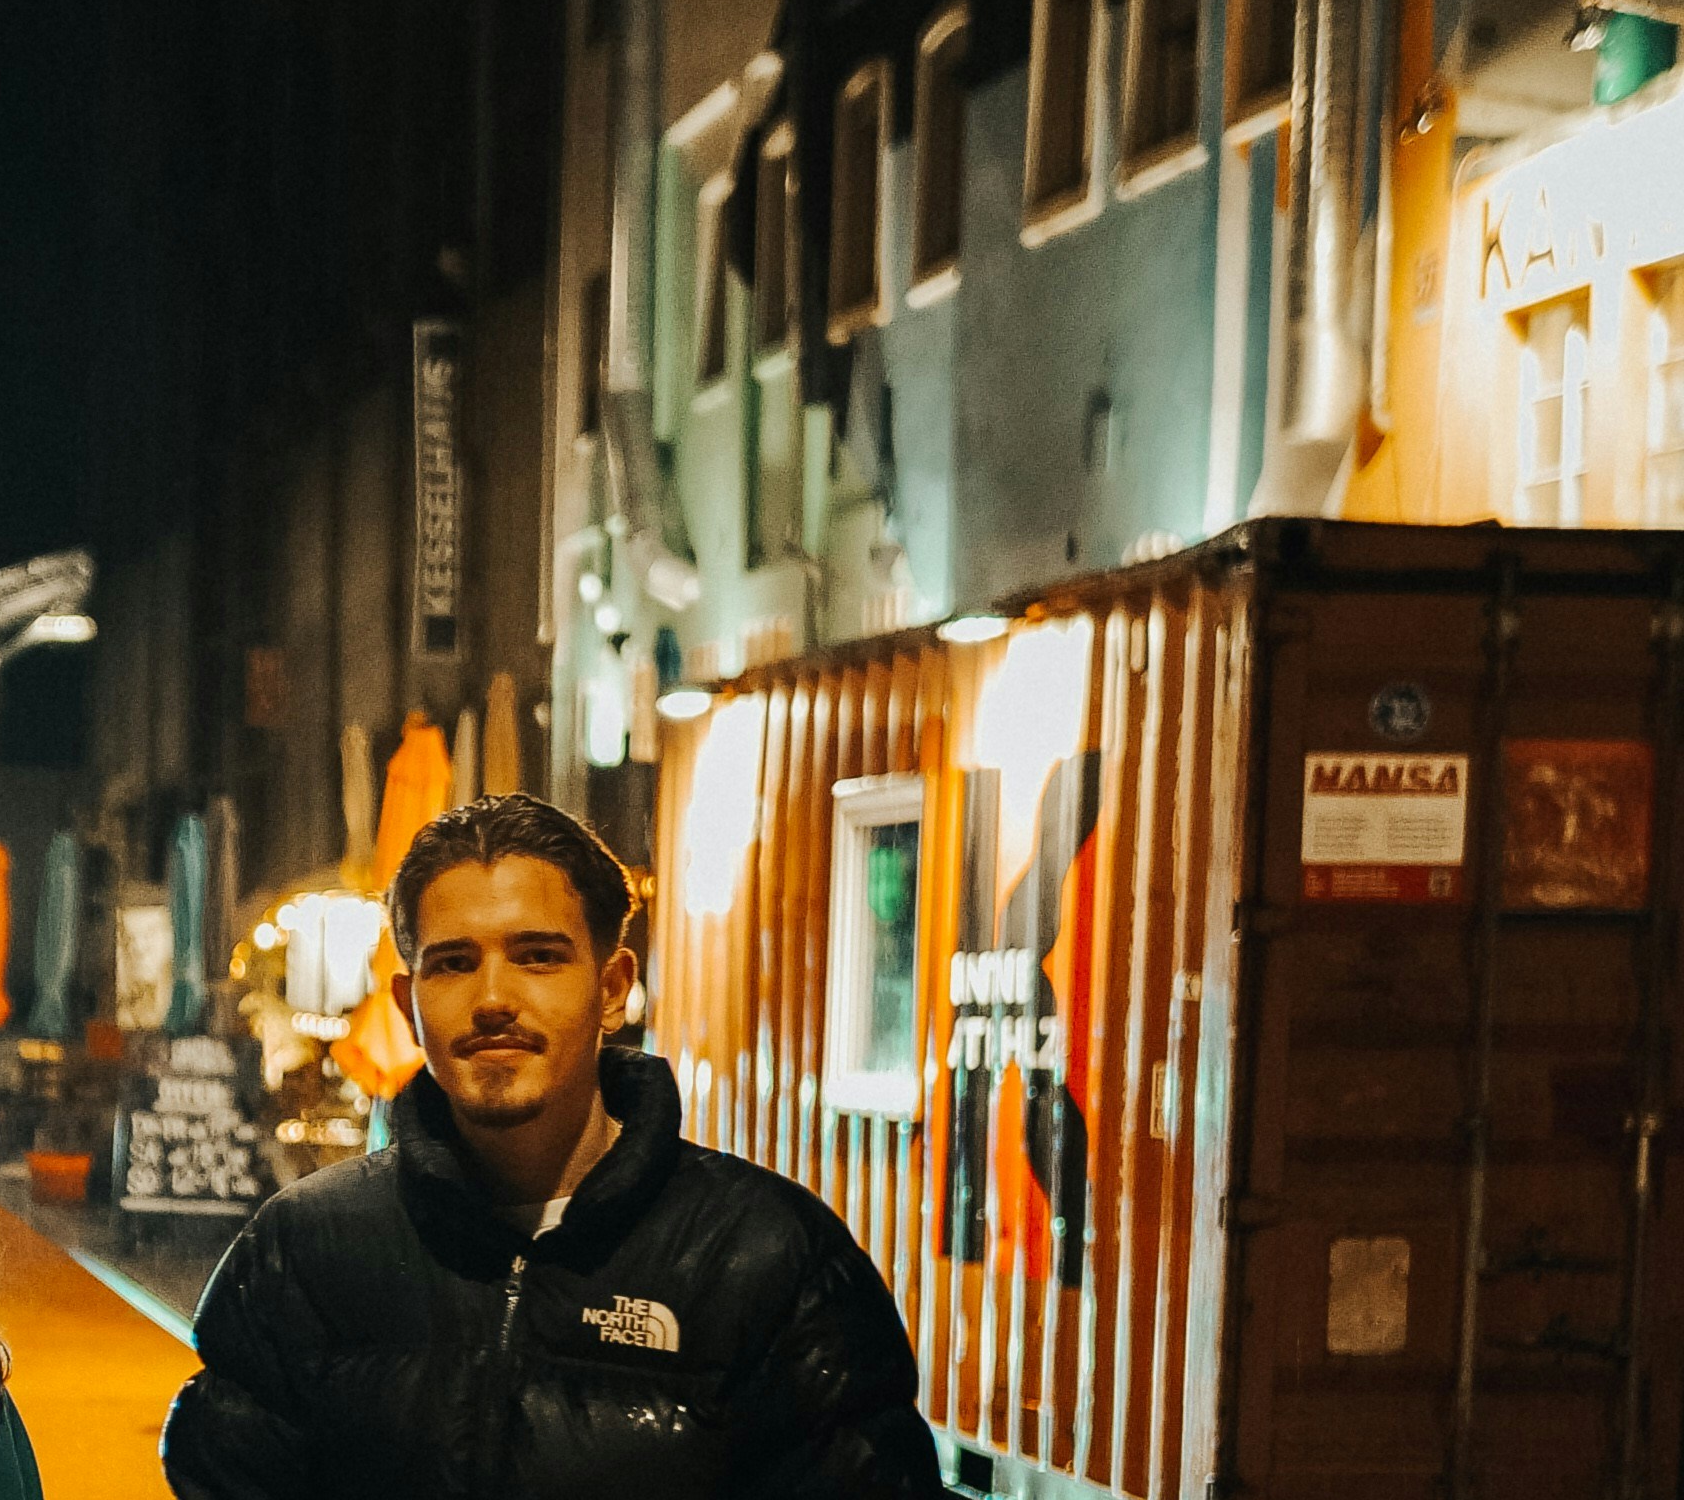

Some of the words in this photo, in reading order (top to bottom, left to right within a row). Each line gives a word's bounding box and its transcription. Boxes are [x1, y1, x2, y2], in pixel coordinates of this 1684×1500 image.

[1311, 763, 1459, 795] HANSA
[612, 1294, 651, 1316] THE
[581, 1307, 649, 1332] NORTH
[599, 1326, 648, 1348] FACE
